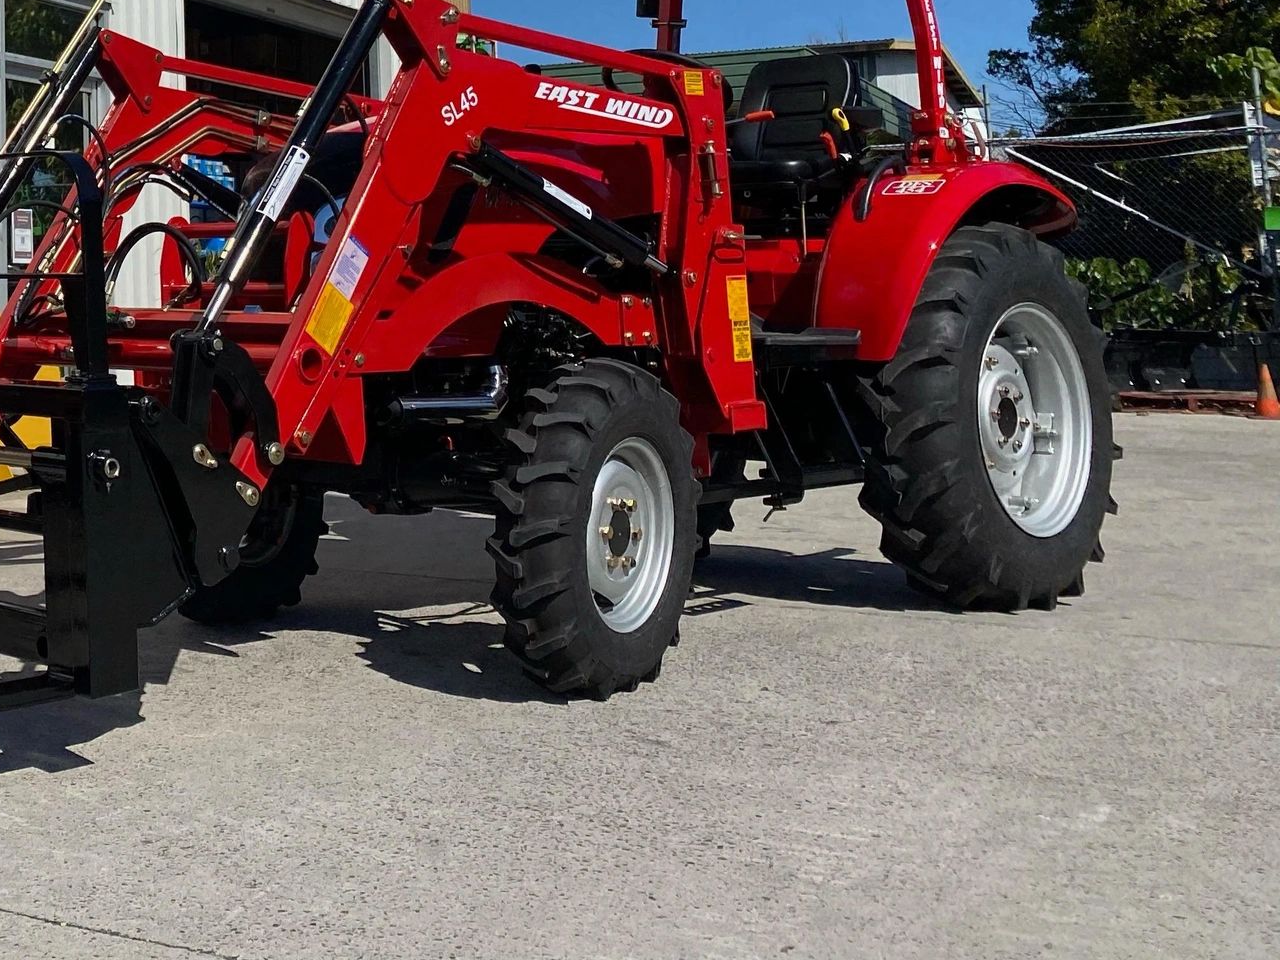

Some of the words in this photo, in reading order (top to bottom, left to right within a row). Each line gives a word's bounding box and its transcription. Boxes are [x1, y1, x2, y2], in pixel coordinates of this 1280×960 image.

[534, 82, 600, 109] EAST
[605, 98, 673, 126] WIND
[933, 56, 944, 108] WIND
[441, 86, 478, 126] SL45
